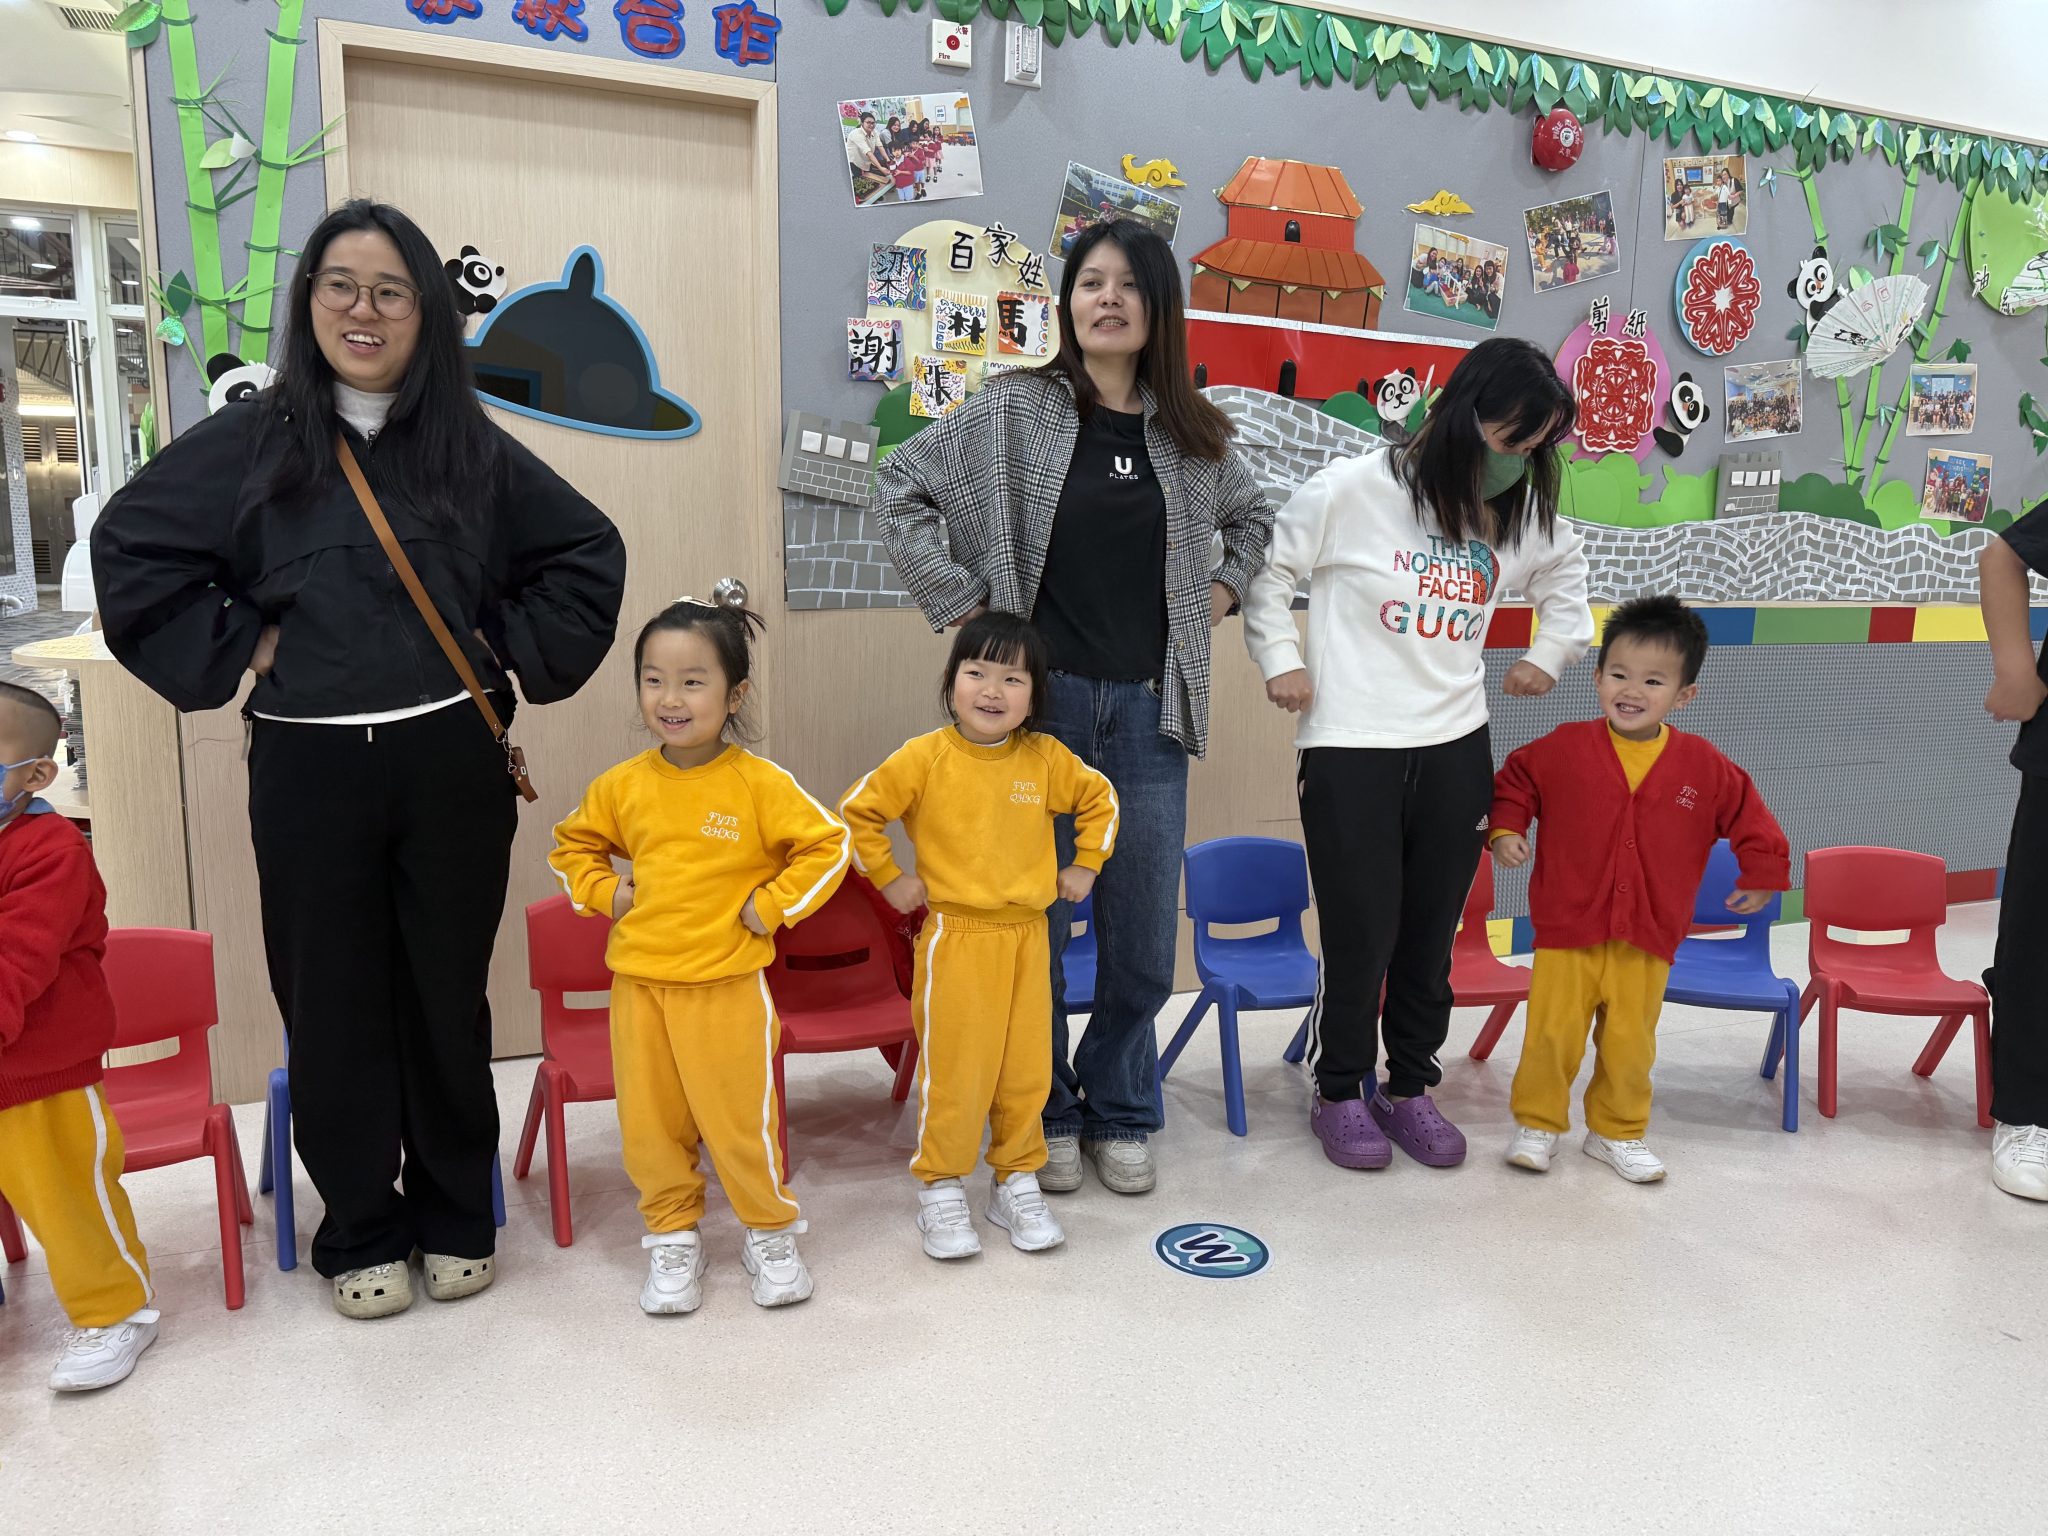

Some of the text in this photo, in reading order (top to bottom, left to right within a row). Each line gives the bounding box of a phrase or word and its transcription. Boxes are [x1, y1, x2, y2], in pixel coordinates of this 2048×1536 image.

[938, 52, 951, 60] Fire
[1552, 119, 1581, 145] FIRE ALARM
[950, 224, 1044, 288] 百家姓
[874, 250, 906, 297] 梁
[948, 311, 986, 344] 林
[999, 300, 1028, 347] 馬
[1592, 296, 1647, 337] 剪紙
[849, 328, 901, 373] 謝
[922, 364, 953, 405] 張
[1114, 455, 1133, 475] U
[1427, 534, 1469, 560] THE
[1393, 550, 1471, 580] NORTH
[1418, 575, 1471, 603] FACE
[1012, 781, 1037, 791] FYTS
[701, 825, 740, 841] QHKG
[705, 811, 738, 827] FYTS
